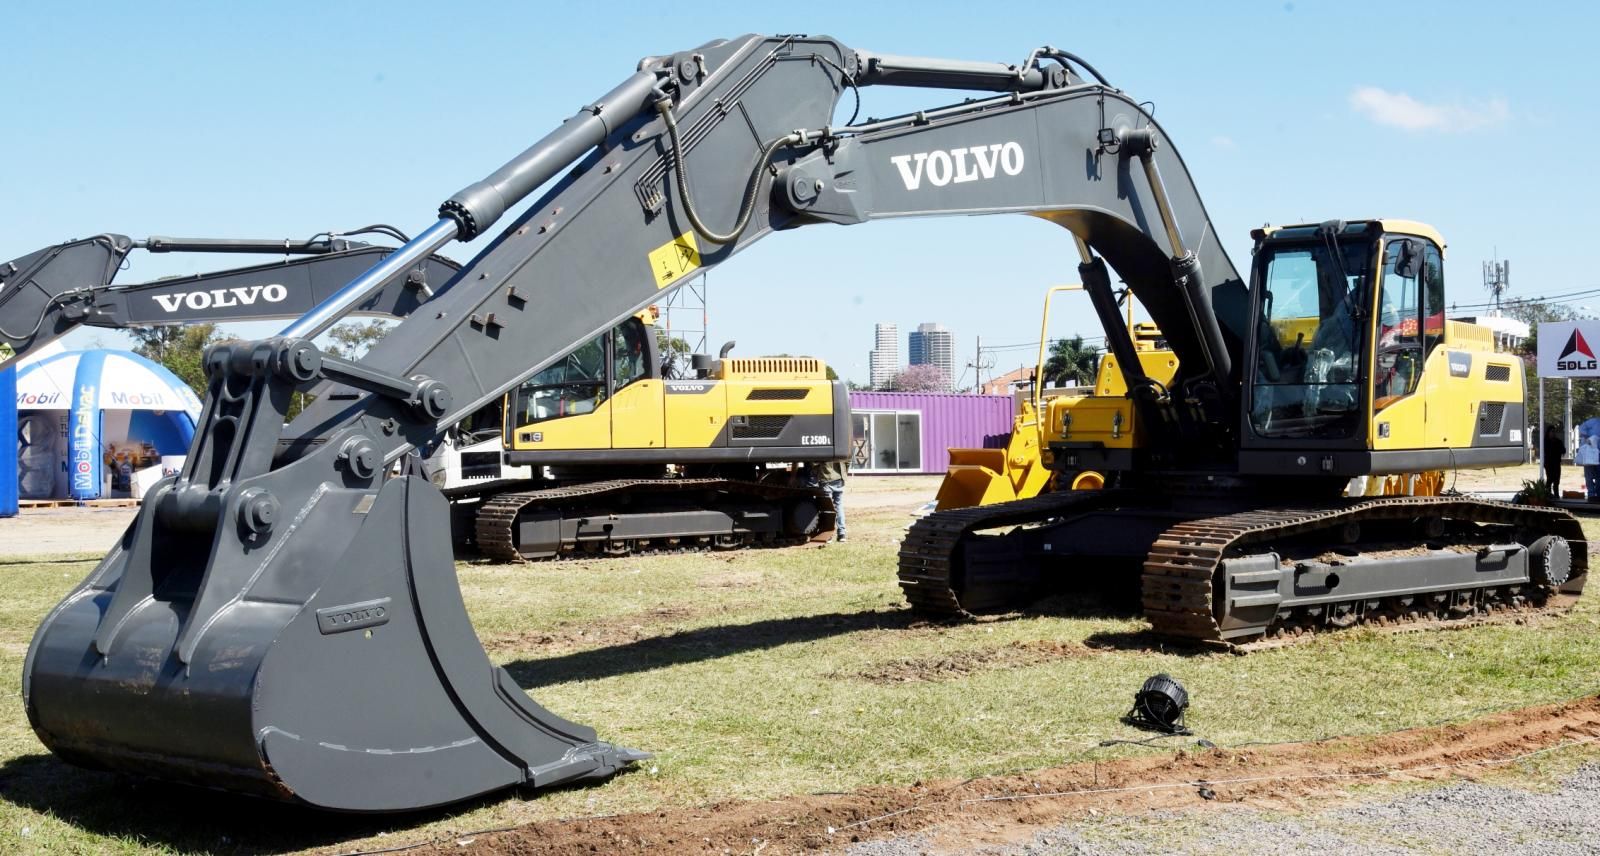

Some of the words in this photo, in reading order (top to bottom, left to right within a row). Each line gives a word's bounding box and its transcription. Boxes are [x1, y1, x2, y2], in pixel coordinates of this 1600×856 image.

[890, 141, 1025, 191] VOLVO
[152, 284, 288, 313] VOLVO
[1557, 360, 1597, 371] SDLG
[111, 391, 165, 405] Mobil
[801, 435, 810, 445] EC
[74, 440, 93, 490] Mobil
[326, 606, 386, 626] VOLVO
